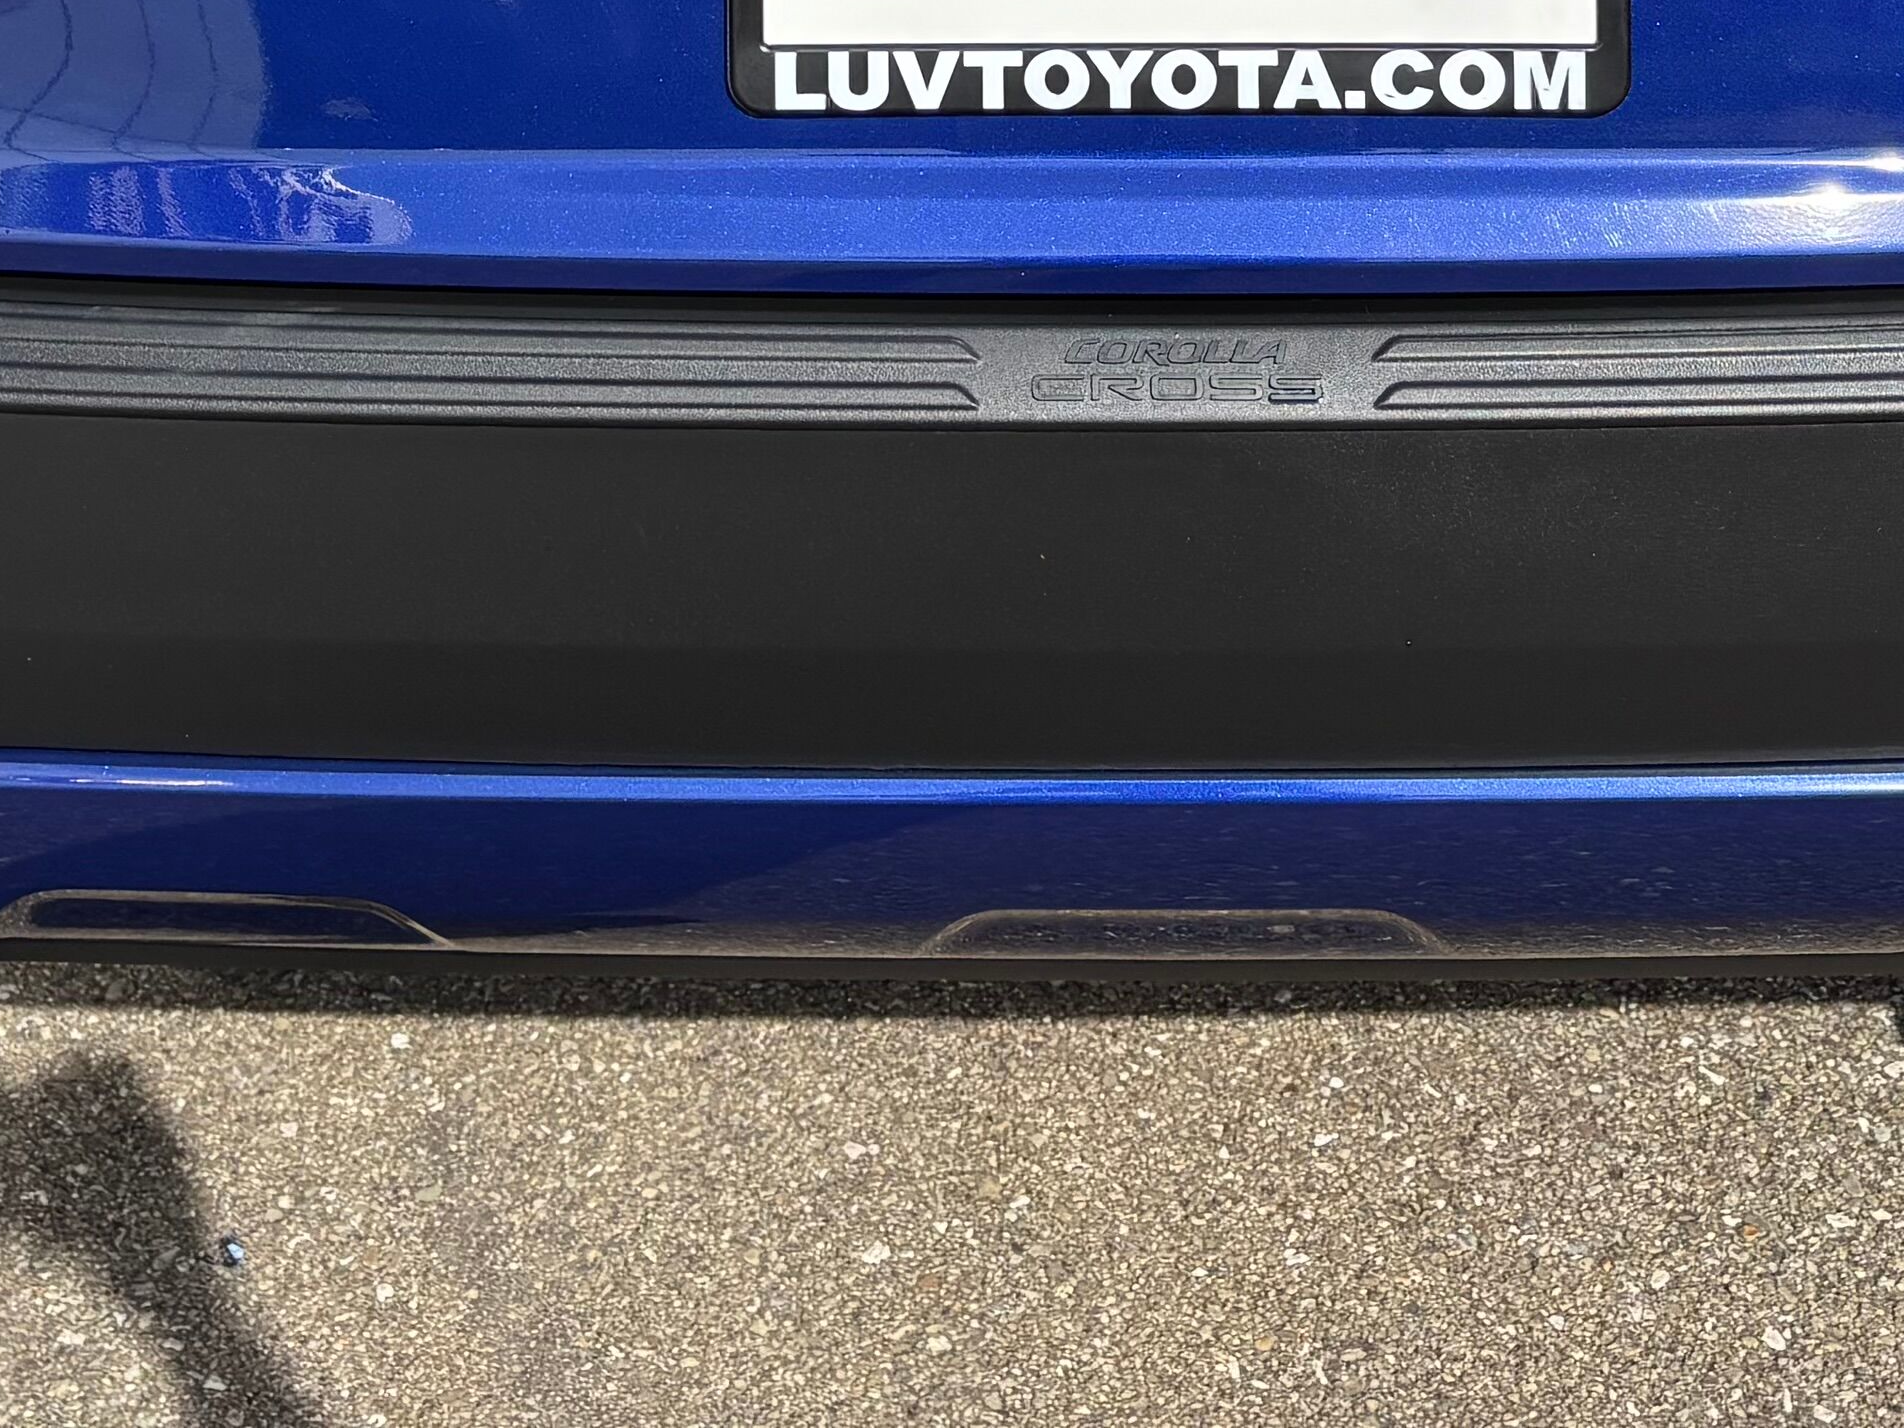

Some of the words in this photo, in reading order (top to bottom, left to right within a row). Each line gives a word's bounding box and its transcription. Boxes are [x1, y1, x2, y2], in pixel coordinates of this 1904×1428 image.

[772, 50, 1588, 111] LUVTOYOTA.COM
[1064, 339, 1288, 367] COROLLA
[1030, 373, 1325, 405] CROSS
